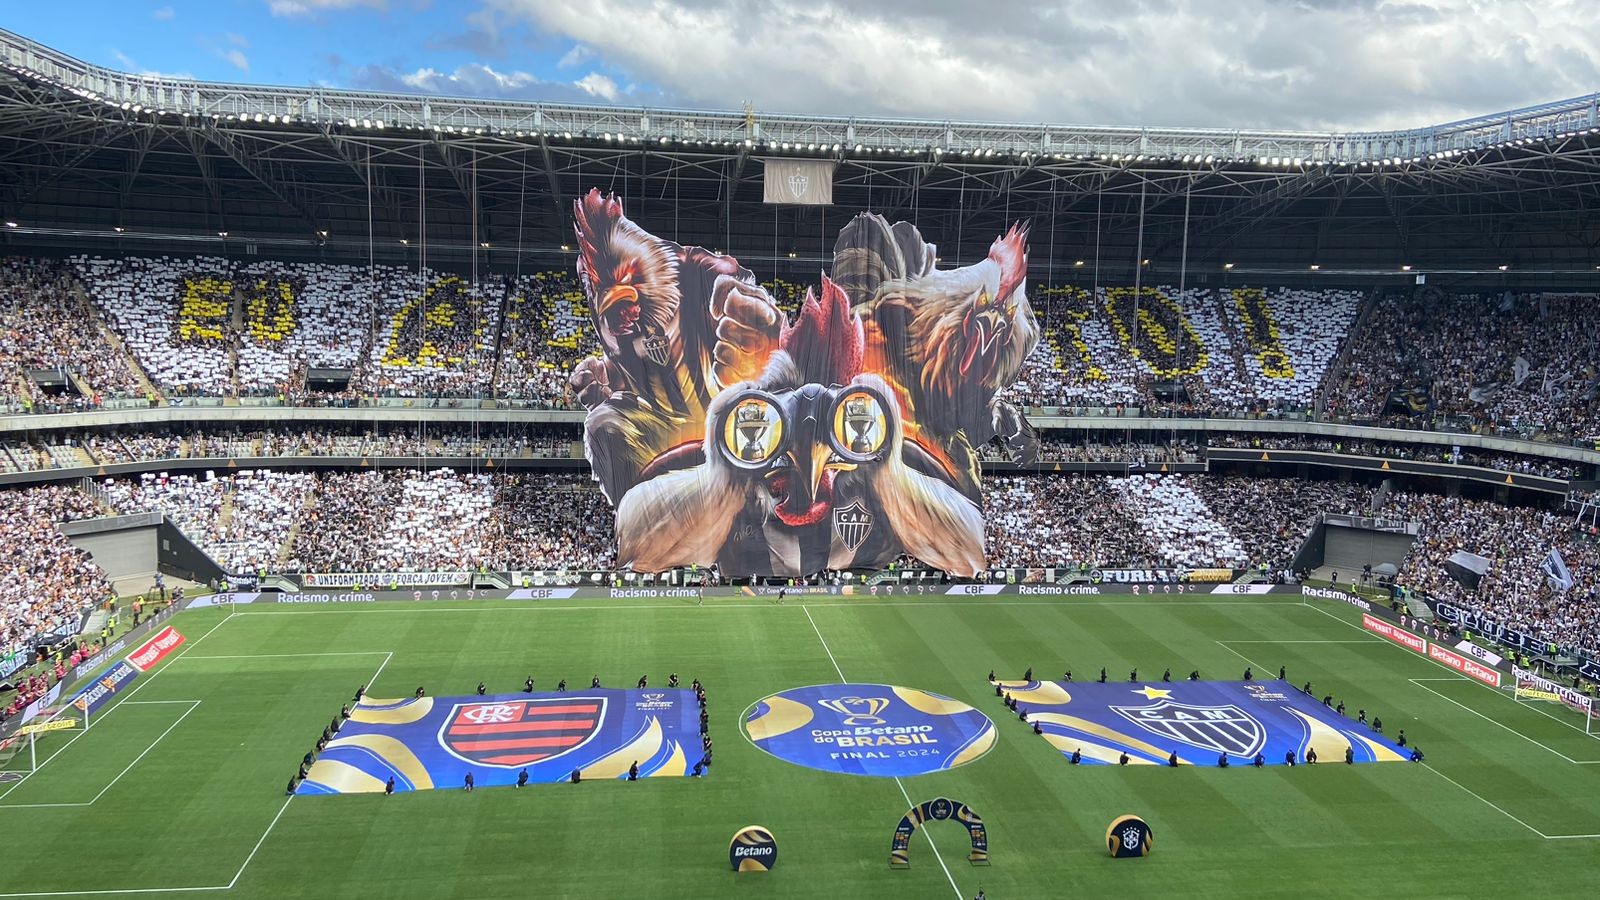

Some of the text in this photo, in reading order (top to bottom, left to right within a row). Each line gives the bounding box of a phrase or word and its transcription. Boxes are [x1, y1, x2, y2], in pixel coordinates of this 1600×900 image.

[840, 513, 869, 522] CAM
[318, 574, 379, 585] UNIFORMIZADA
[425, 573, 454, 584] JOVEM
[531, 589, 553, 598] CBF
[610, 588, 657, 598] Racismo
[666, 587, 699, 597] crime.
[964, 585, 984, 594] CBF
[1019, 584, 1062, 594] Racismo
[1070, 584, 1100, 594] crime.
[1232, 585, 1252, 593] CBF
[211, 594, 235, 604] CBF
[278, 593, 330, 603] Racismo
[339, 592, 376, 602] crime.
[1302, 585, 1347, 601] Racismo
[1352, 597, 1371, 612] crime.
[1471, 645, 1487, 659] CBF
[1431, 647, 1496, 683] Betano Betano
[1139, 709, 1232, 720] CAM
[811, 724, 933, 738] Copa Betano
[814, 733, 938, 748] do BRASIL
[830, 748, 940, 760] FINAL 2024
[735, 846, 772, 857] Betano
